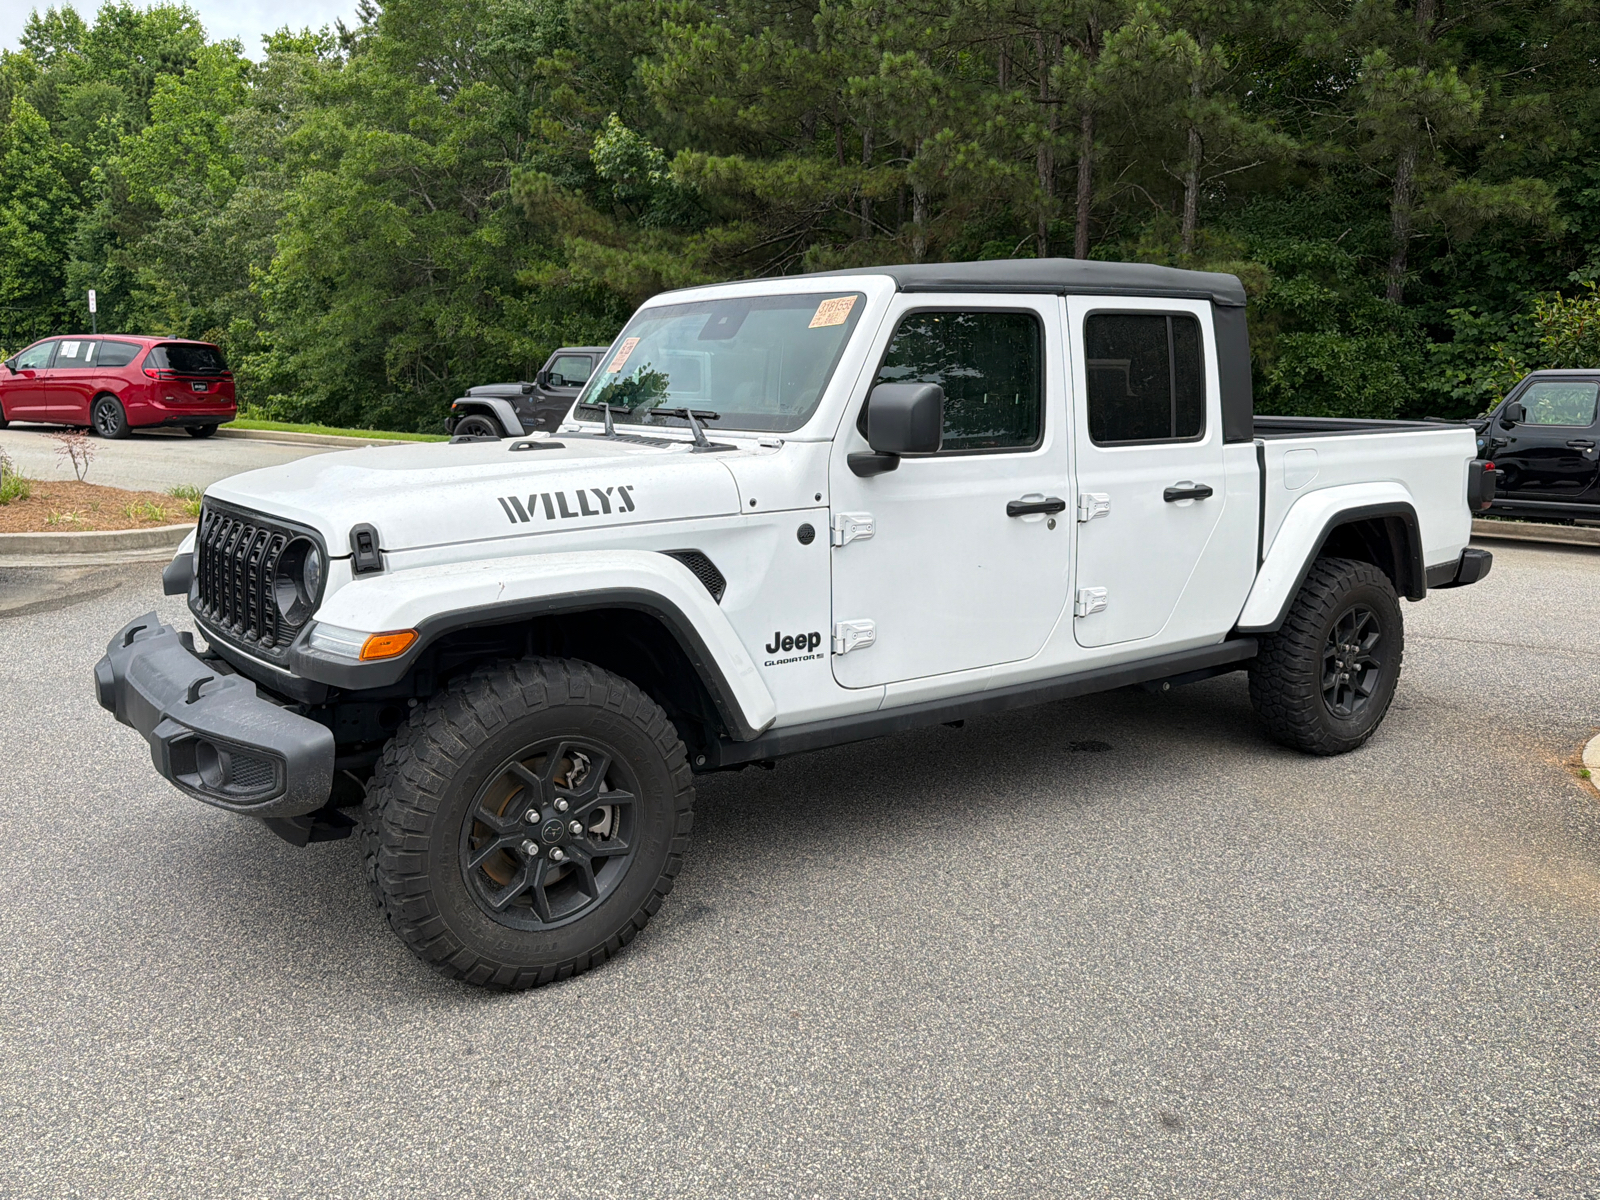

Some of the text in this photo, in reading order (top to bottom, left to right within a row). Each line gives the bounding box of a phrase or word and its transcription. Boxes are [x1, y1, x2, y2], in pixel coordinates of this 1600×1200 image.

[497, 485, 635, 523] WILLYS
[765, 631, 821, 654] Jeep
[764, 654, 815, 667] GLADIATOR
